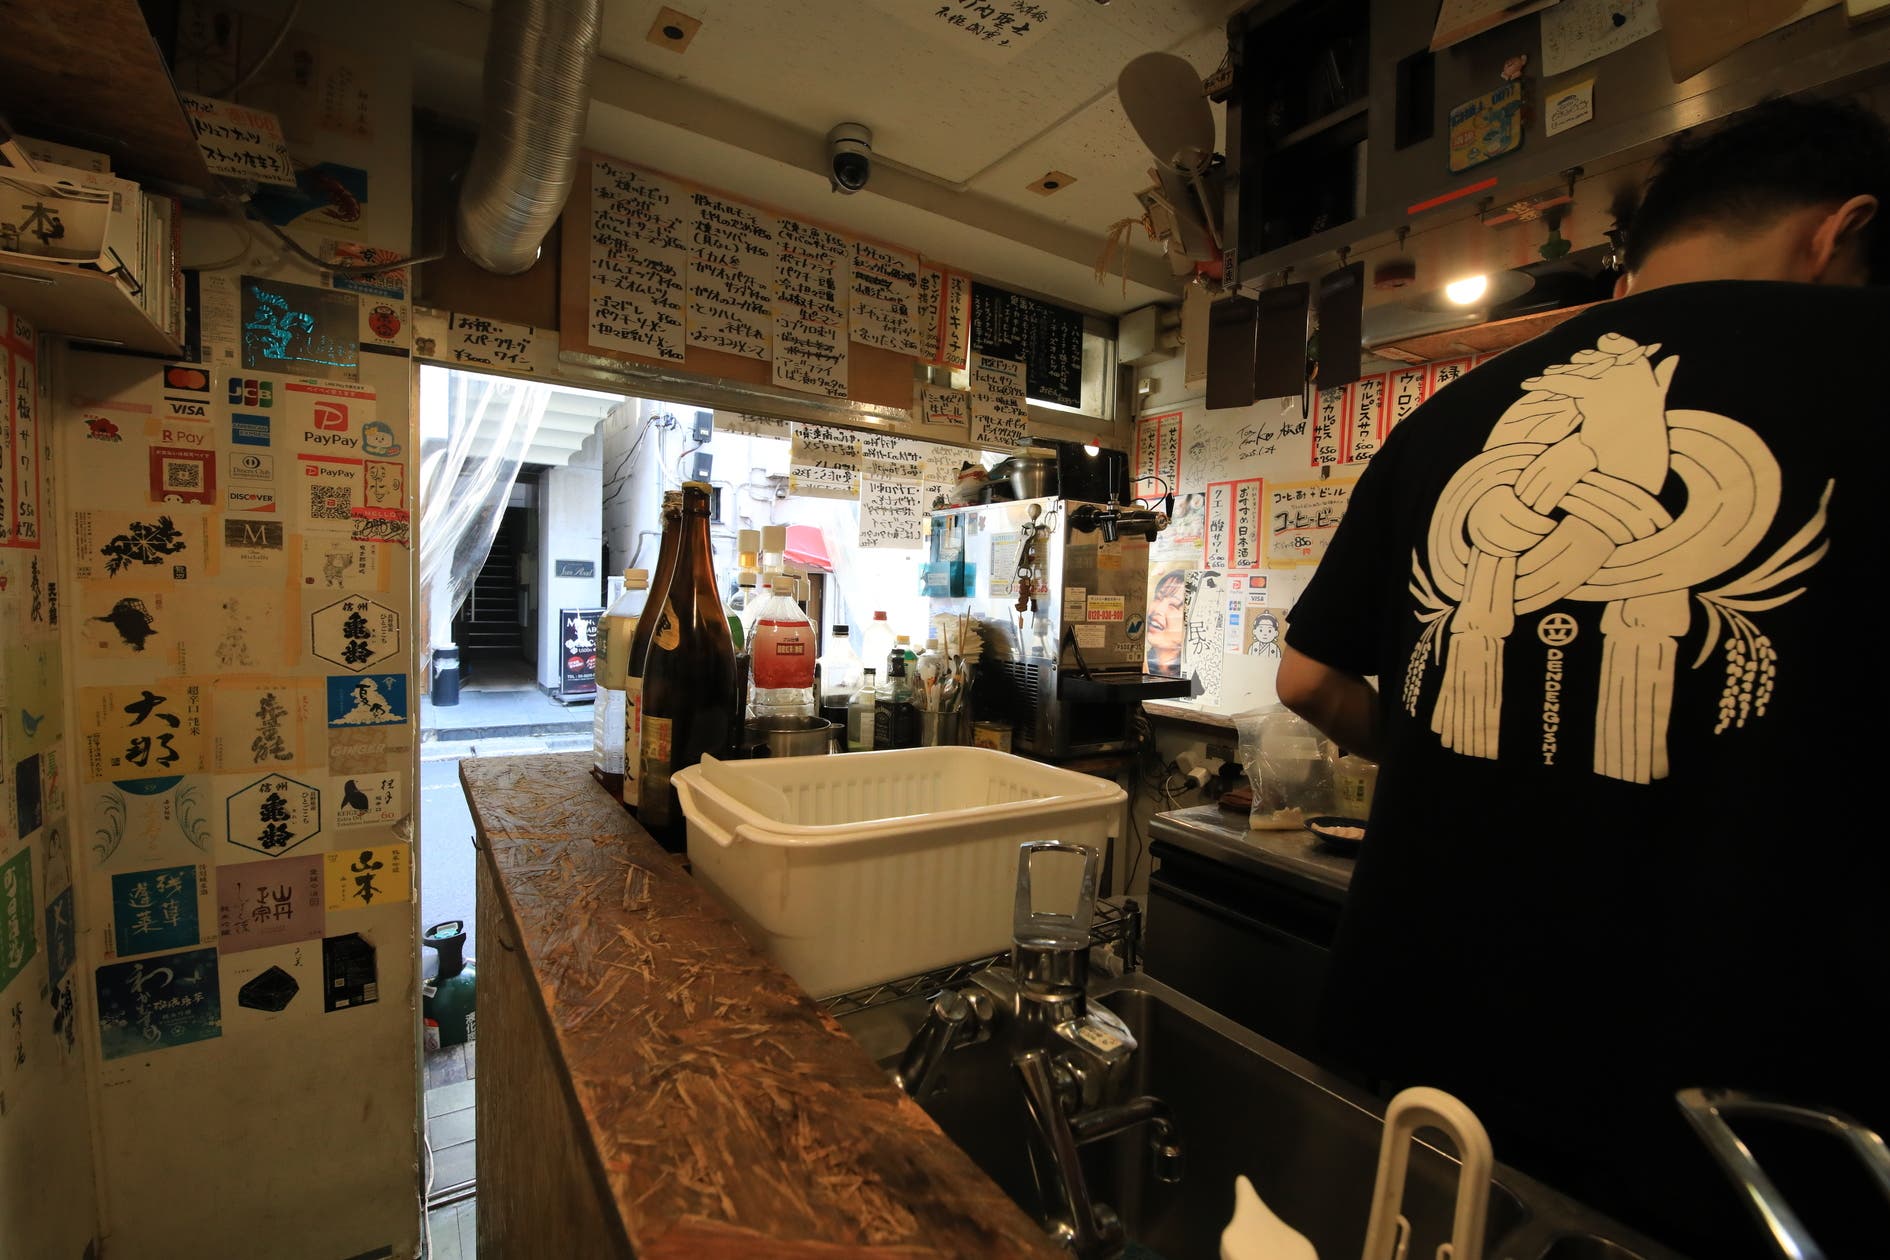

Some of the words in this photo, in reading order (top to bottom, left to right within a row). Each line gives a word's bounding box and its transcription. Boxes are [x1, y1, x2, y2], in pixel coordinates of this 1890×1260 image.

[463, 333, 532, 354] スパークリング
[494, 350, 532, 364] ワイン
[170, 403, 206, 417] VISA
[1358, 380, 1374, 442] カルピスサワー
[1322, 404, 1337, 440] カルピス
[177, 431, 205, 446] Pay
[304, 431, 359, 449] PayPay
[1355, 442, 1374, 451] 500
[320, 467, 356, 479] PayPay
[230, 492, 273, 502] DISCOVER
[1319, 487, 1347, 498] ビール
[1210, 489, 1225, 553] クエン酸サワー
[1237, 485, 1251, 558] おすすめ日本酒
[242, 524, 268, 545] M
[1294, 536, 1312, 548] 850
[1541, 648, 1564, 765] DENDENGUSHI
[330, 742, 387, 758] GINGER
[259, 781, 289, 793] 信州
[350, 850, 385, 906] 山本
